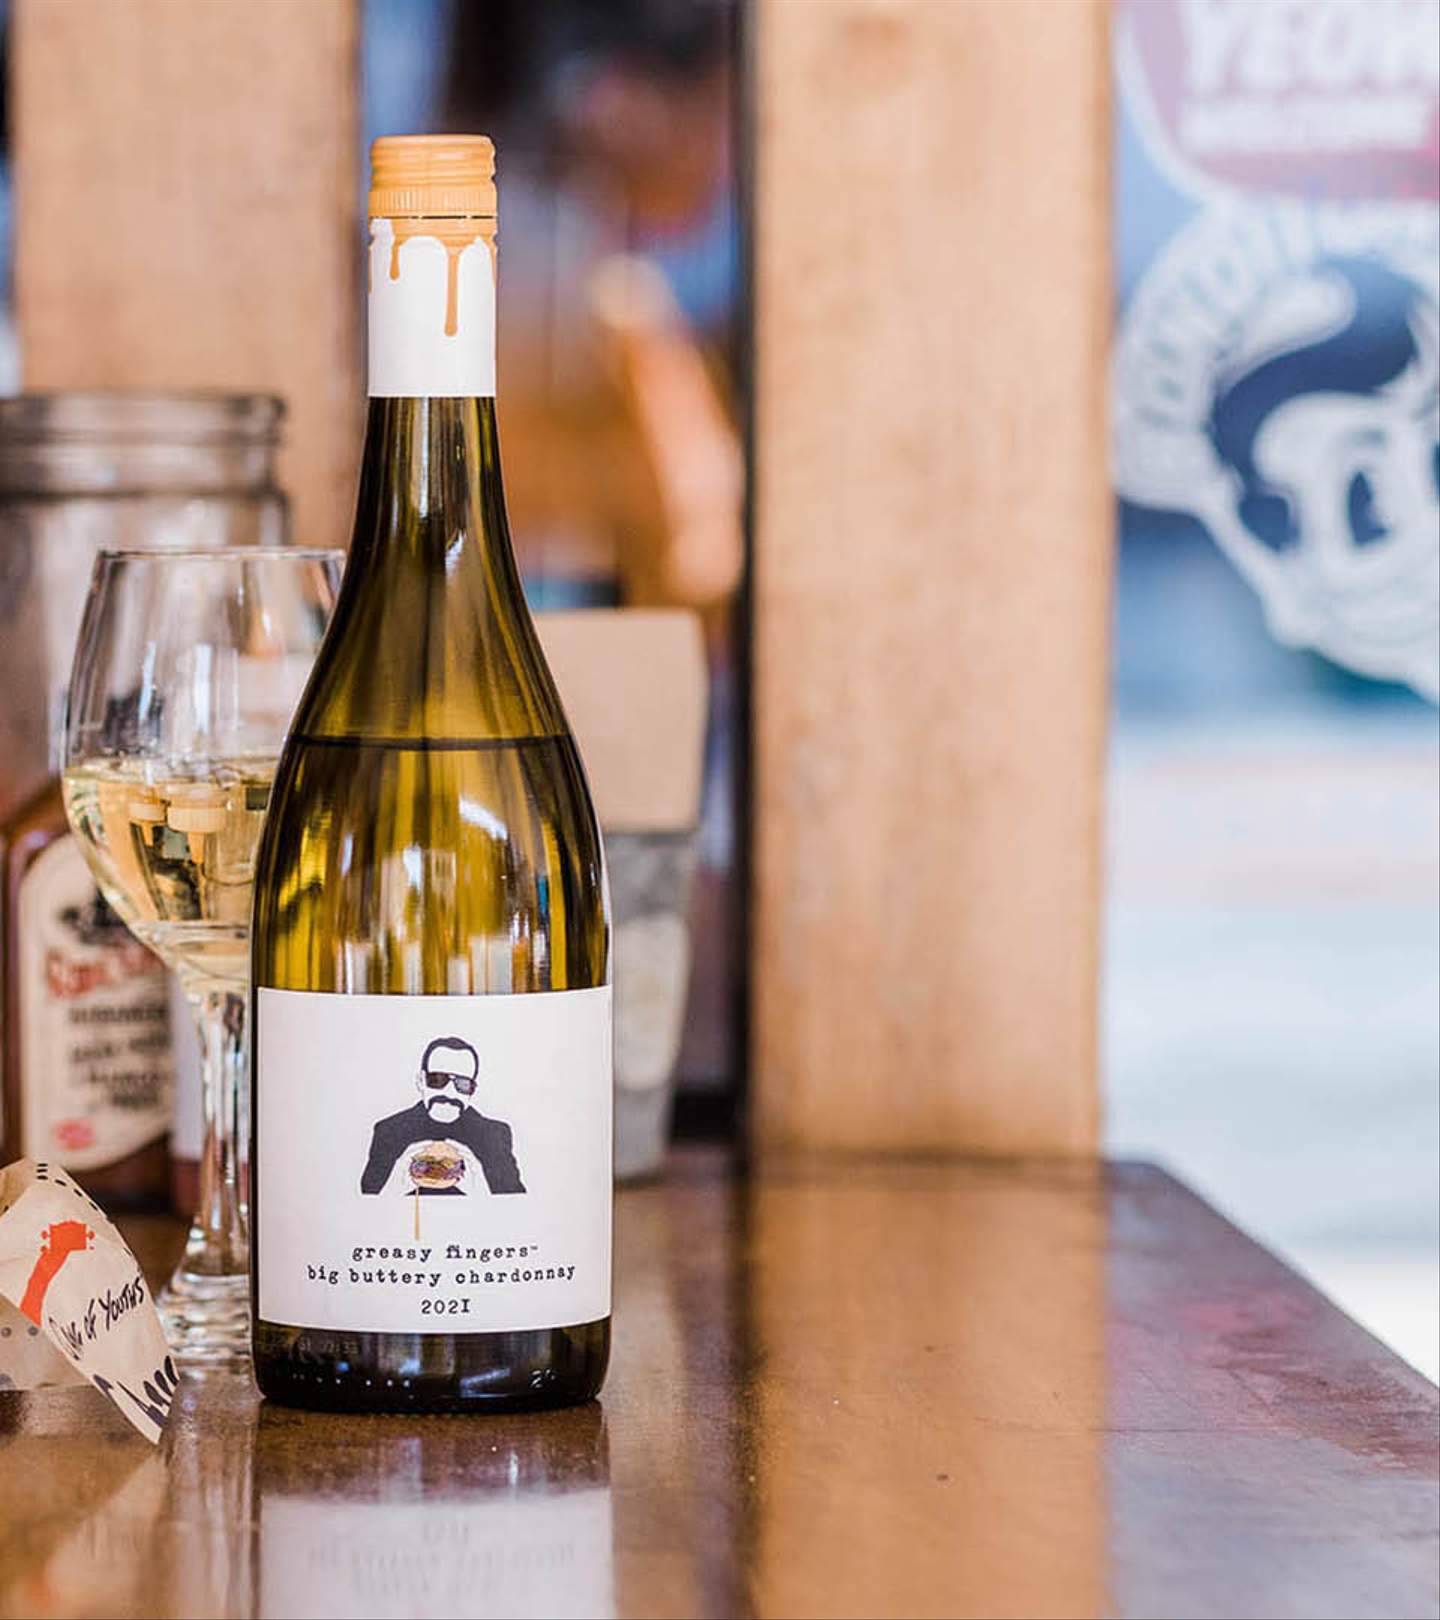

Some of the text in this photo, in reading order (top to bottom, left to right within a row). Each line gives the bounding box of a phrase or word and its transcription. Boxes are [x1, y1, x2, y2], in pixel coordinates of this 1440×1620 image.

[352, 1247, 432, 1263] greasy
[307, 1264, 575, 1288] big buttery chardonnay
[421, 1298, 470, 1315] 2021
